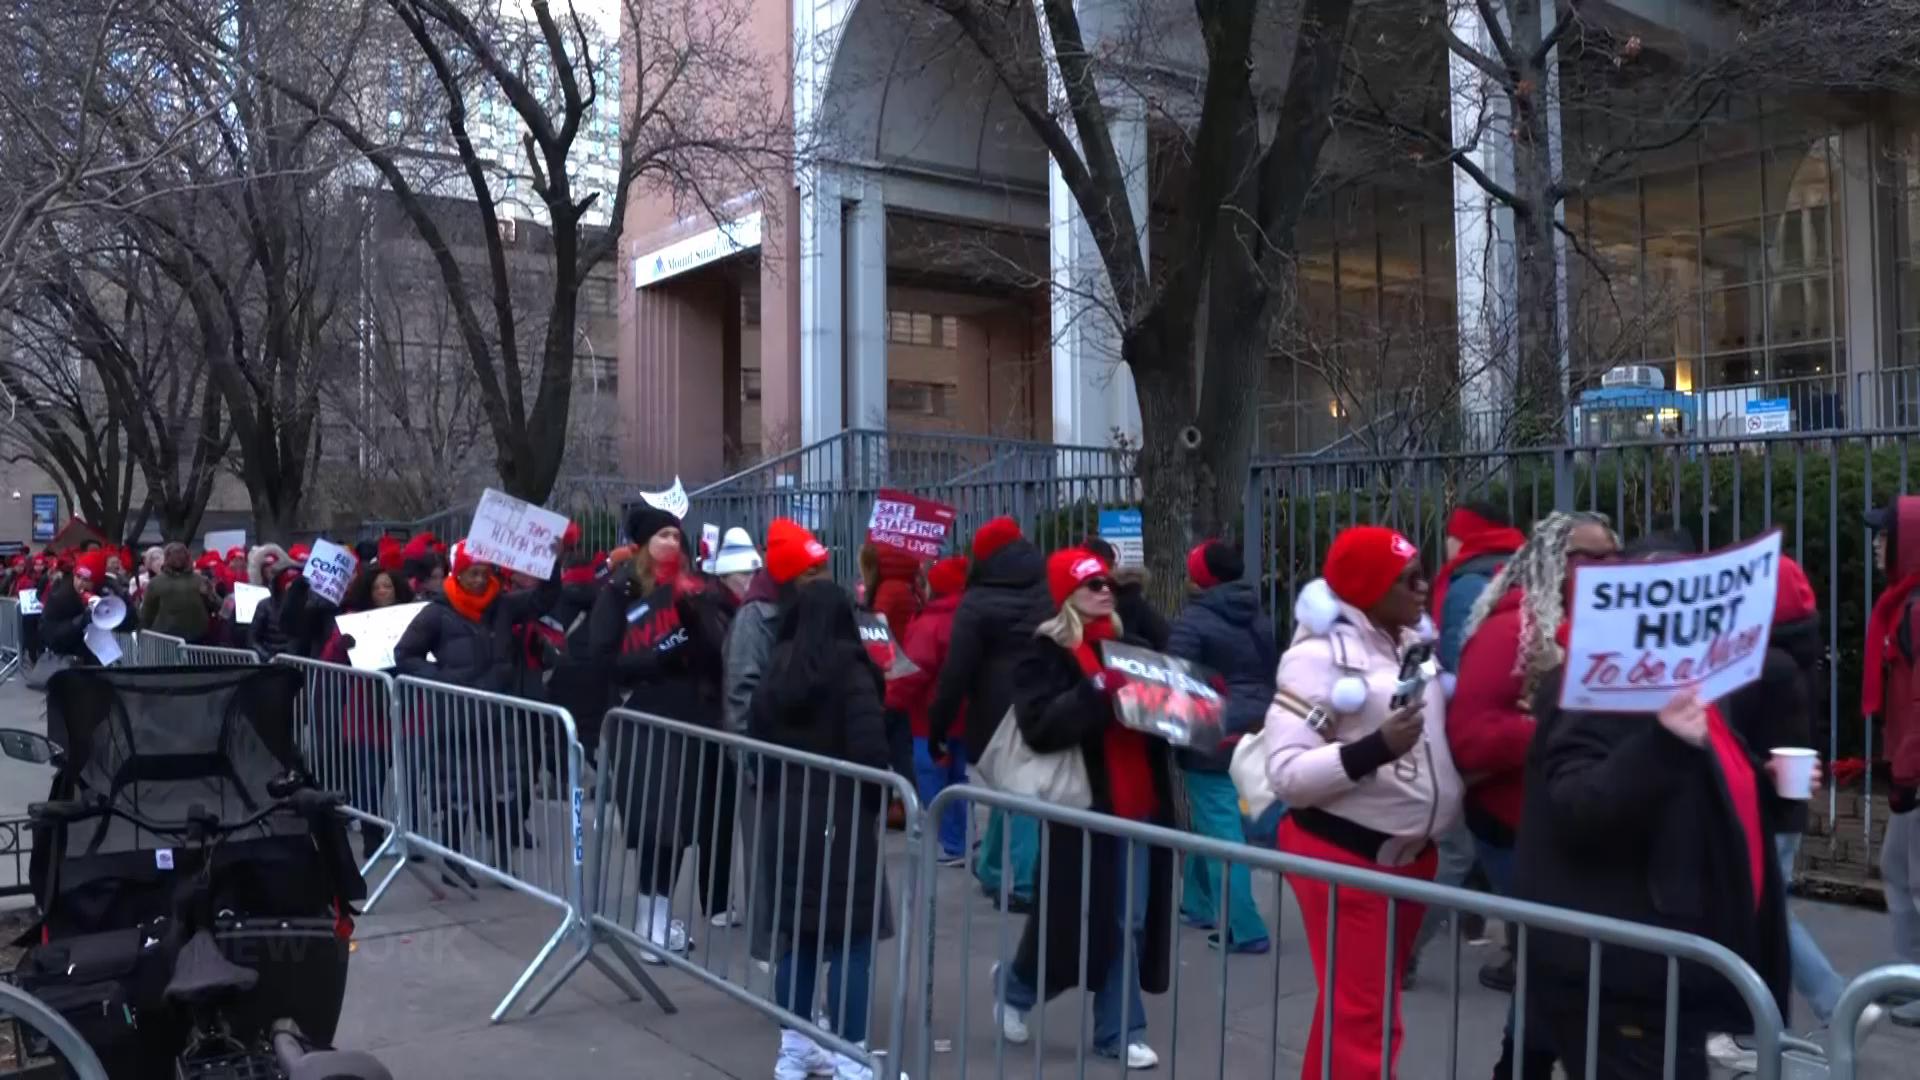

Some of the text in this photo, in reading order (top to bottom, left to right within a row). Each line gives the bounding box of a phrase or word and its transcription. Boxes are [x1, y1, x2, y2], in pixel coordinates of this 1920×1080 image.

[668, 251, 693, 270] Mount
[878, 502, 914, 520] SAFE
[875, 516, 944, 538] STAFFING
[907, 540, 938, 556] LIVES
[1592, 551, 1773, 610] SHOULDN'T
[1634, 595, 1744, 650] HURT
[1581, 651, 1623, 686] To
[1626, 650, 1667, 685] be
[1672, 656, 1696, 682] a
